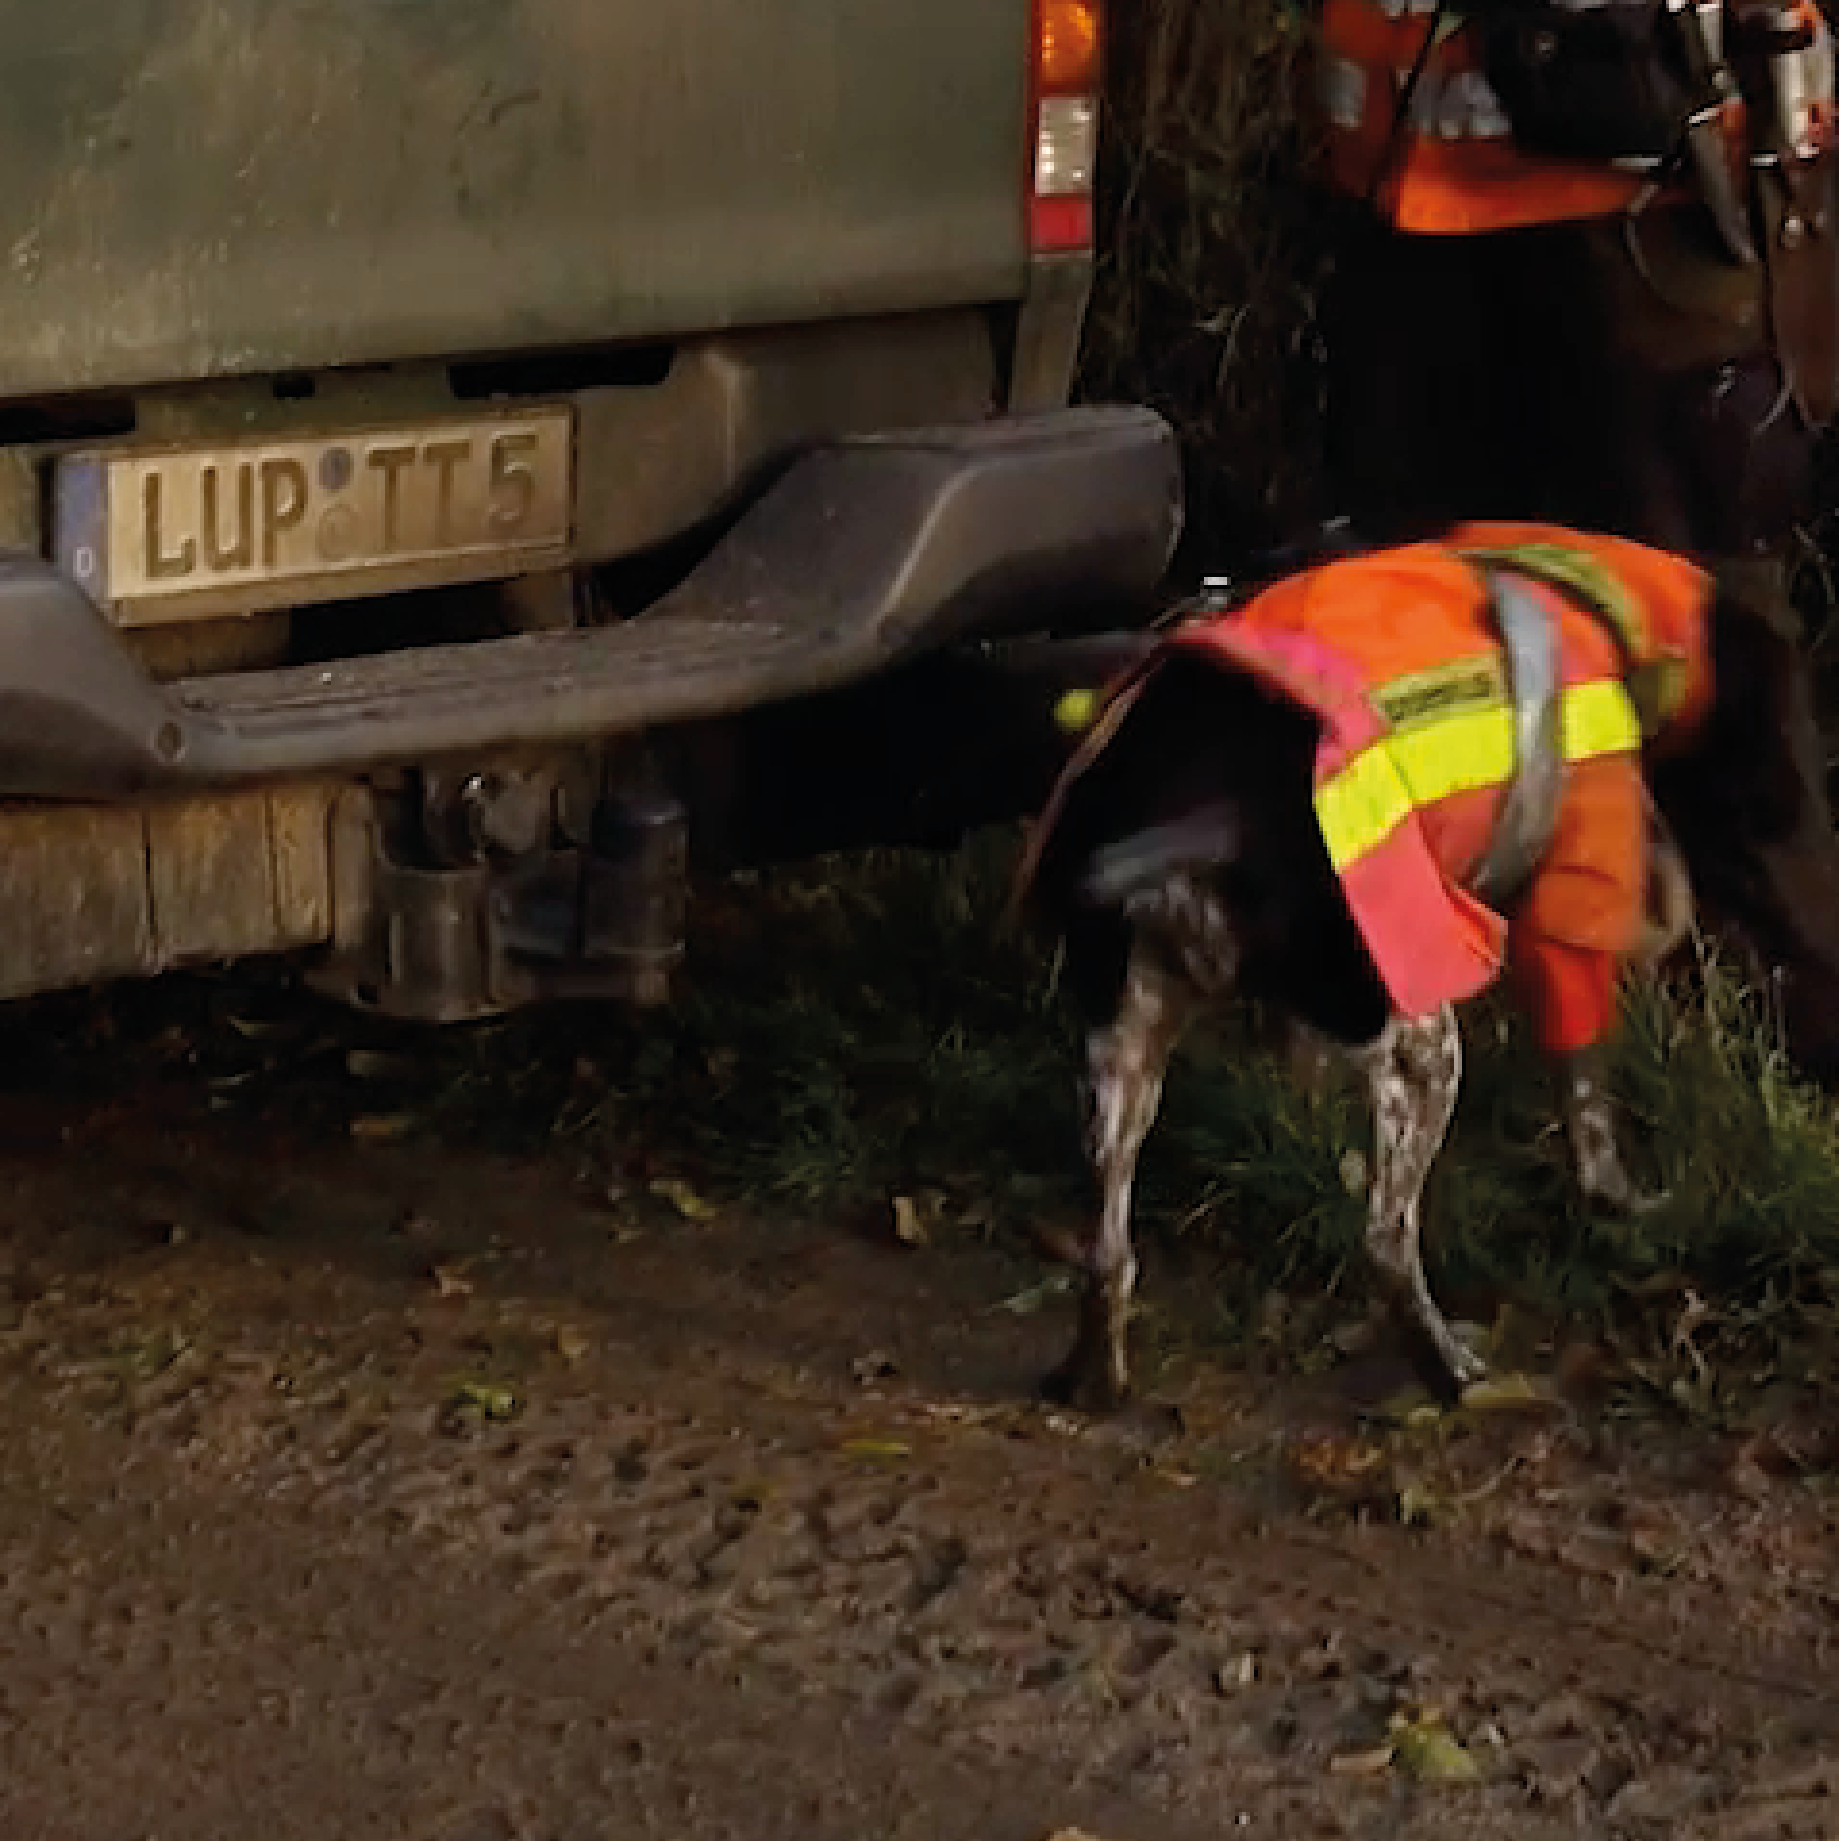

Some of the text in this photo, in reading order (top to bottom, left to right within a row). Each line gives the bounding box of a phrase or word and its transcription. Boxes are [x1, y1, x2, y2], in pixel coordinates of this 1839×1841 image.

[143, 457, 307, 579] LUP
[366, 441, 470, 548] TT
[490, 433, 539, 523] 5
